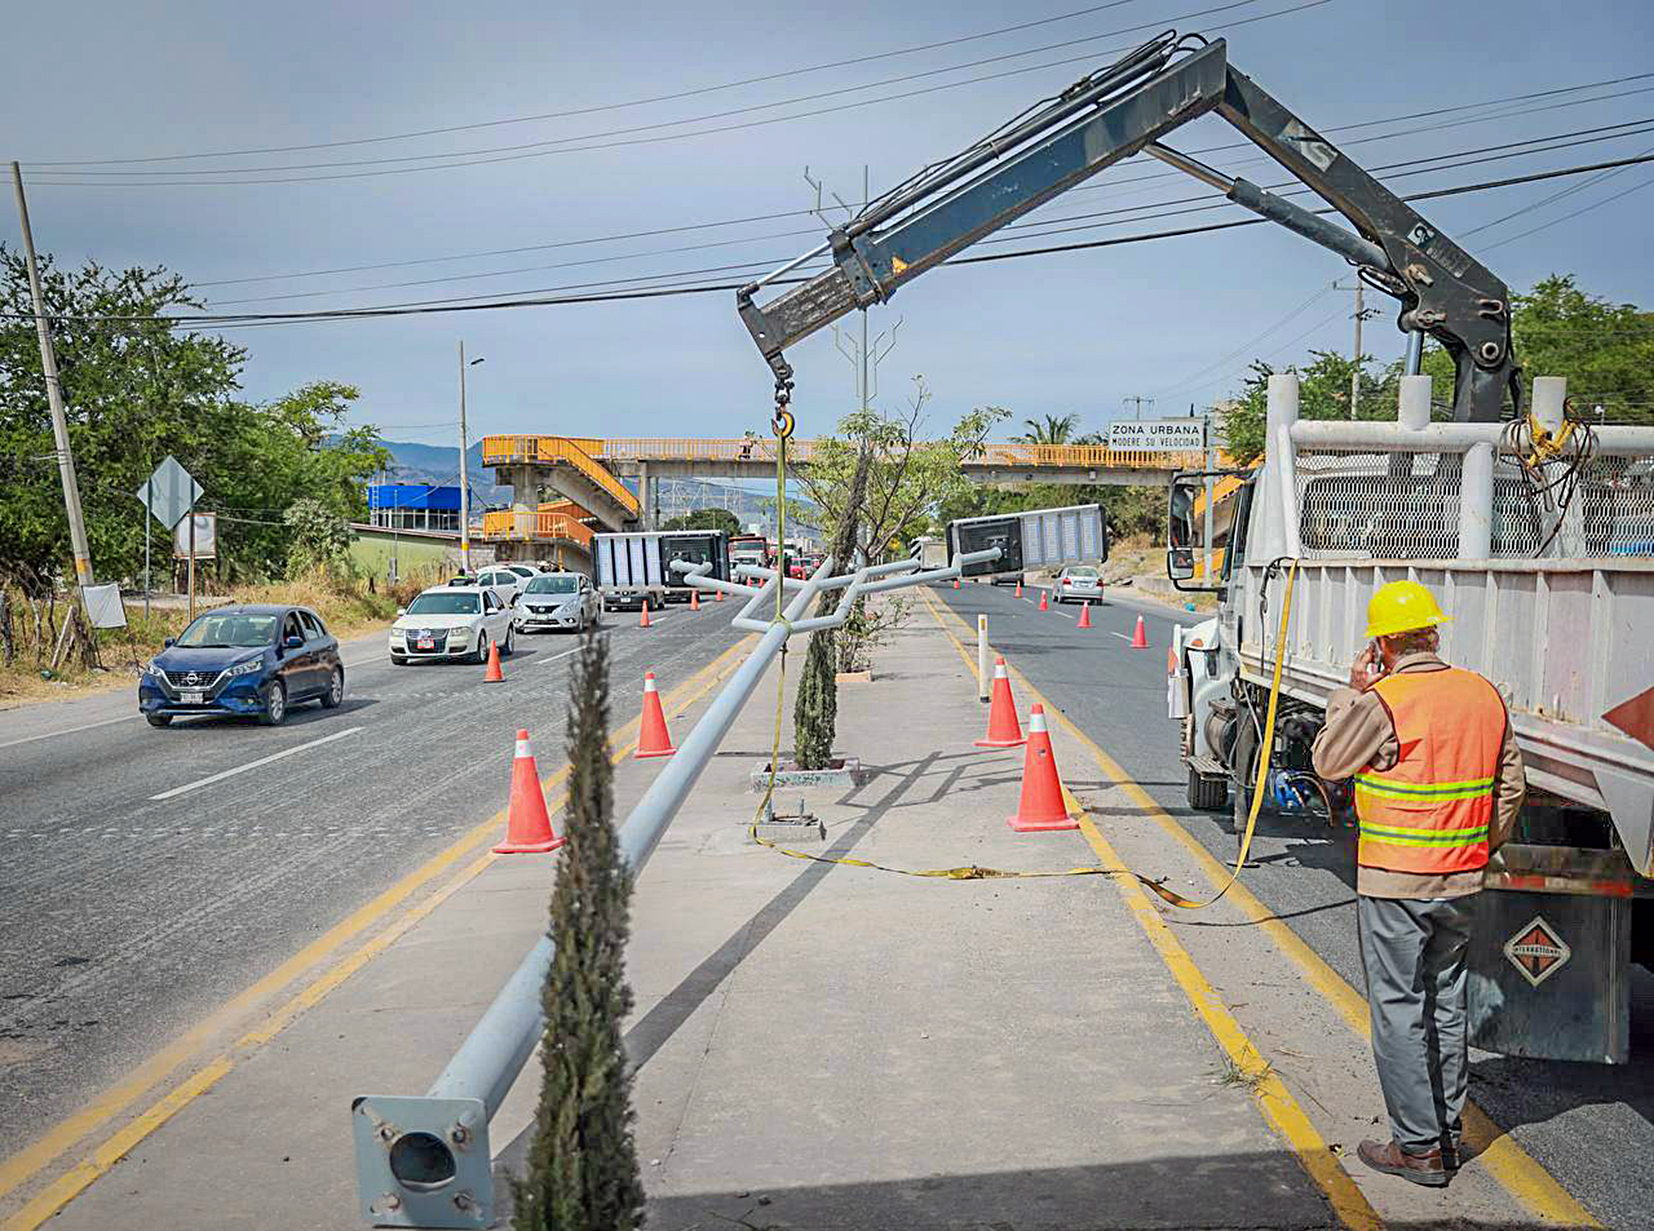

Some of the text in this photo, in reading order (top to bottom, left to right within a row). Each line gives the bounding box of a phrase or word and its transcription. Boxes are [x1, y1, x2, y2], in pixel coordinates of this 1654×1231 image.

[1112, 425, 1200, 435] ZONA URBANA
[1112, 437, 1200, 447] MODERE SU VELOCIDAD
